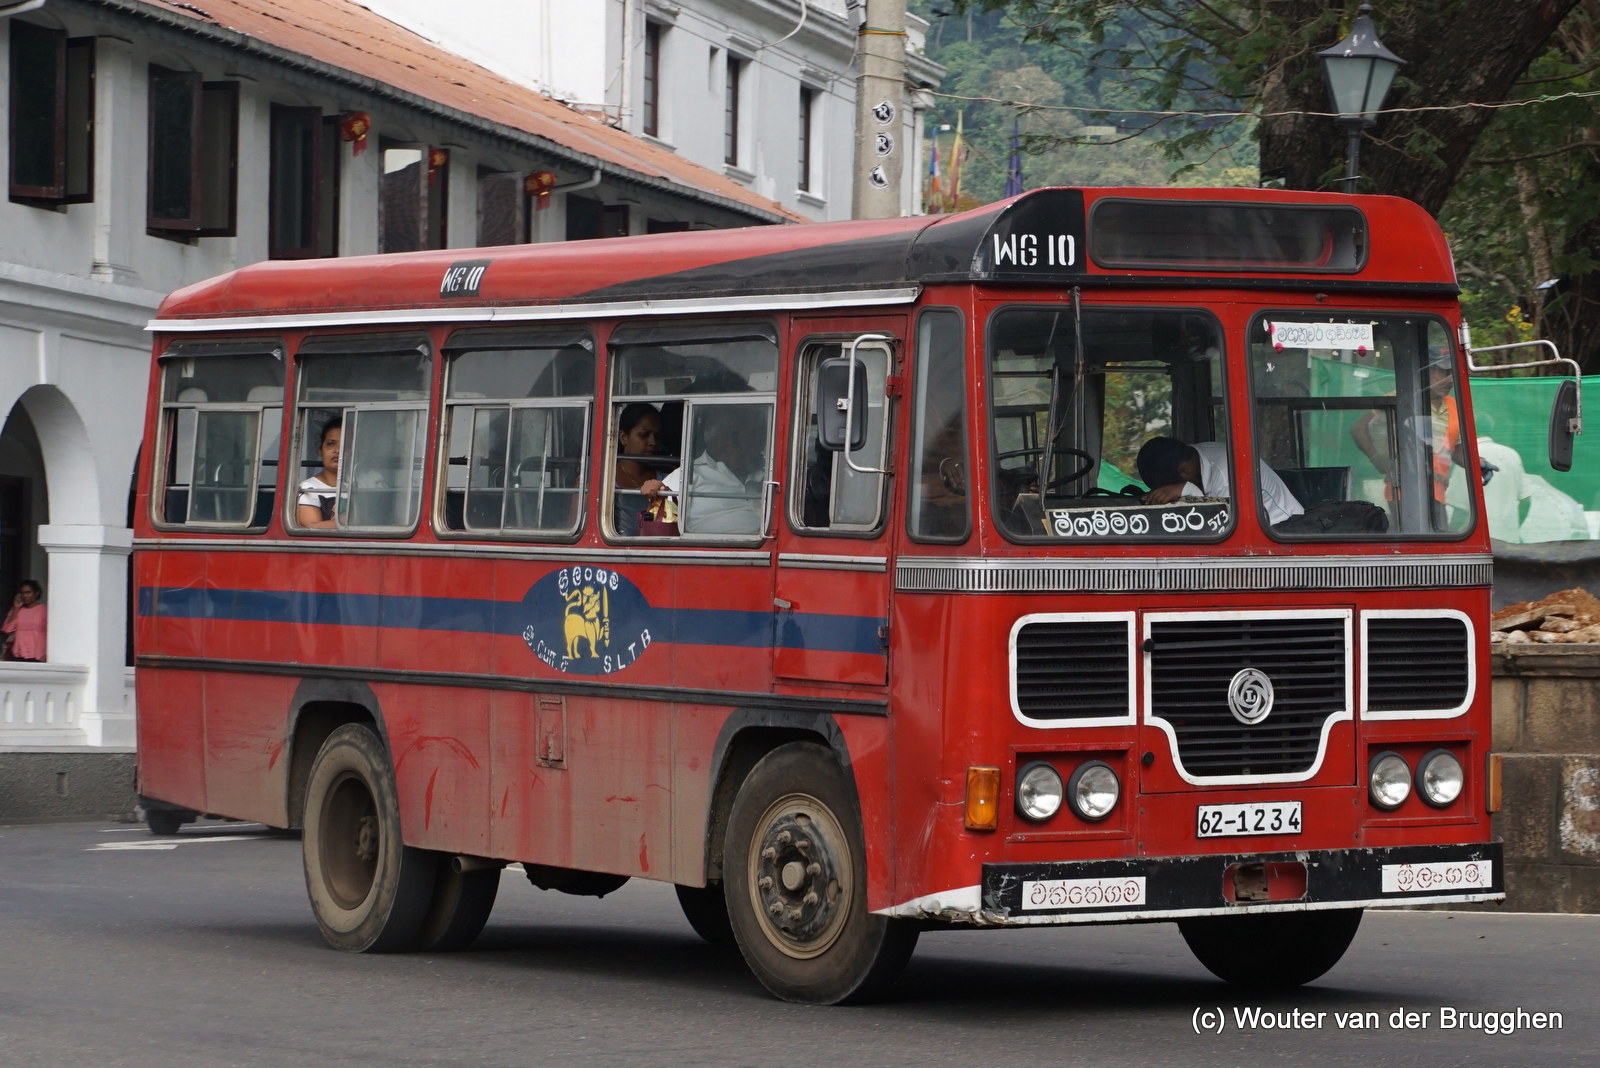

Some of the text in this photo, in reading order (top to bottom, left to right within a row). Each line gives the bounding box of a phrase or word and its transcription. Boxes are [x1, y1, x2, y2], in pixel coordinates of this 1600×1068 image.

[993, 233, 1076, 266] WG 10
[440, 266, 485, 293] WG 10
[1161, 507, 1205, 533] පාර
[1207, 509, 1229, 531] 573
[1199, 807, 1300, 834] 62-1234
